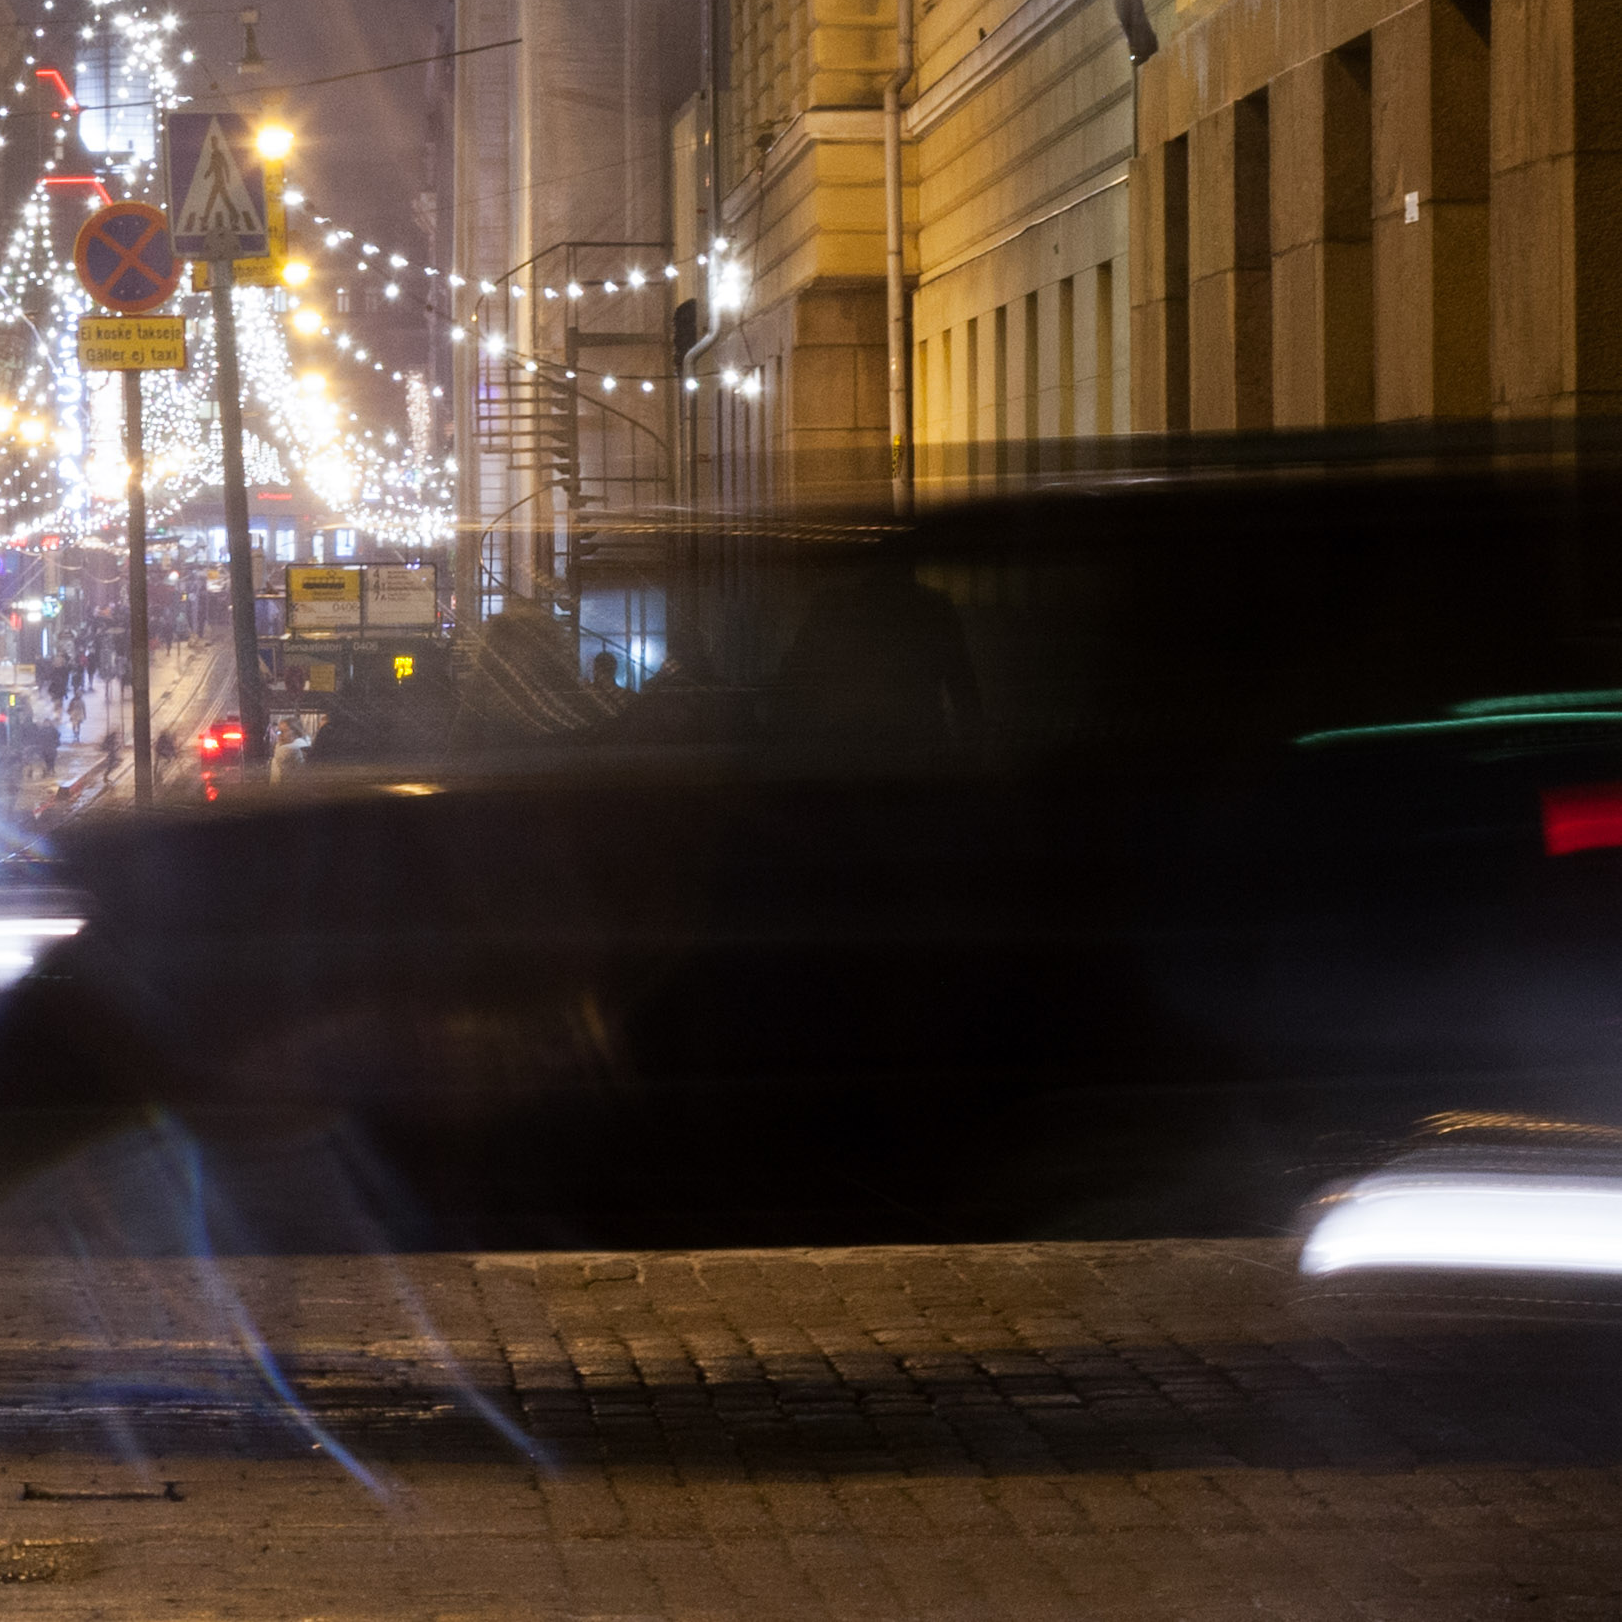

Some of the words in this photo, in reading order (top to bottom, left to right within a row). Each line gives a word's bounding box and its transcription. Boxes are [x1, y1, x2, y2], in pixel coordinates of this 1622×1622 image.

[97, 325, 131, 340] koske
[86, 347, 125, 362] Gäller
[131, 349, 145, 364] ej
[151, 347, 178, 362] taxi
